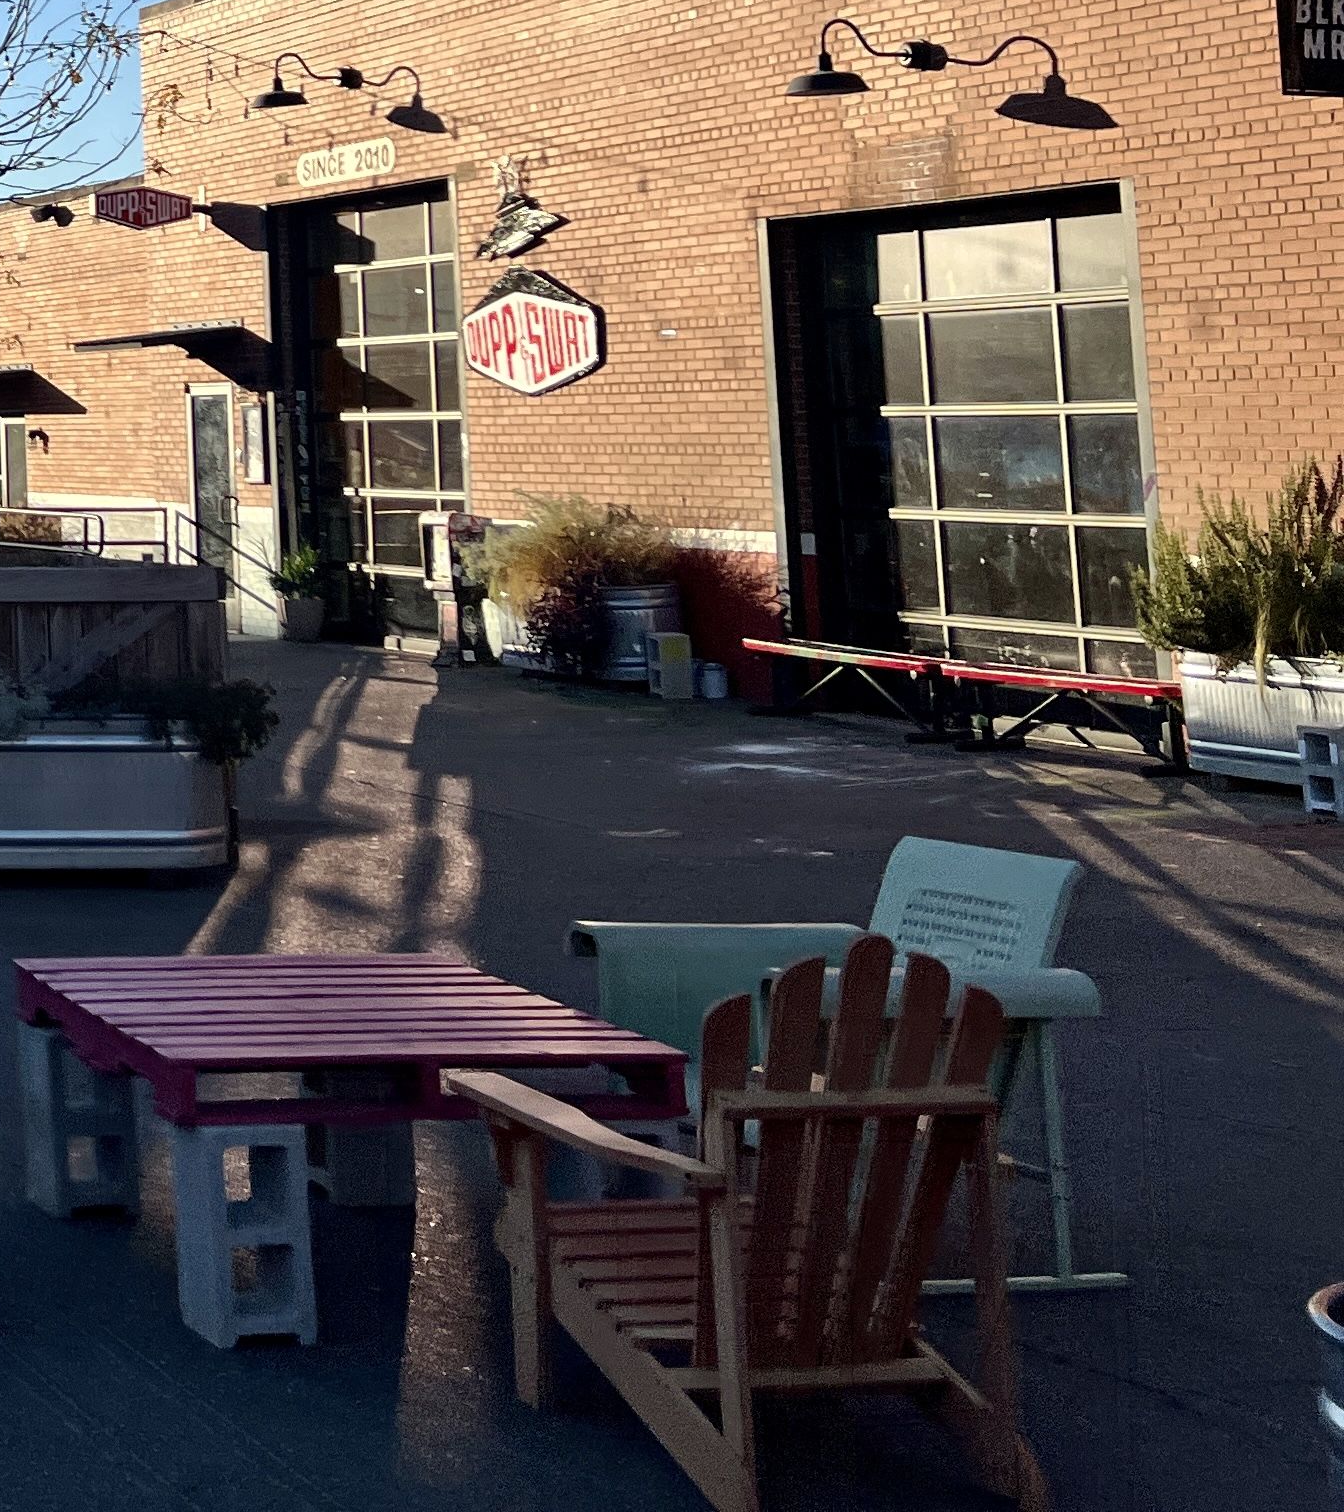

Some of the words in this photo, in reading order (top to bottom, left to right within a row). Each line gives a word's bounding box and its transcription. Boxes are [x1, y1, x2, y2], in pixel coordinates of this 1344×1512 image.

[302, 152, 346, 181] SINCE
[354, 144, 390, 173] 2010
[145, 192, 189, 225] SWAT
[467, 303, 517, 380] DUPP
[524, 301, 589, 384] SWAT
